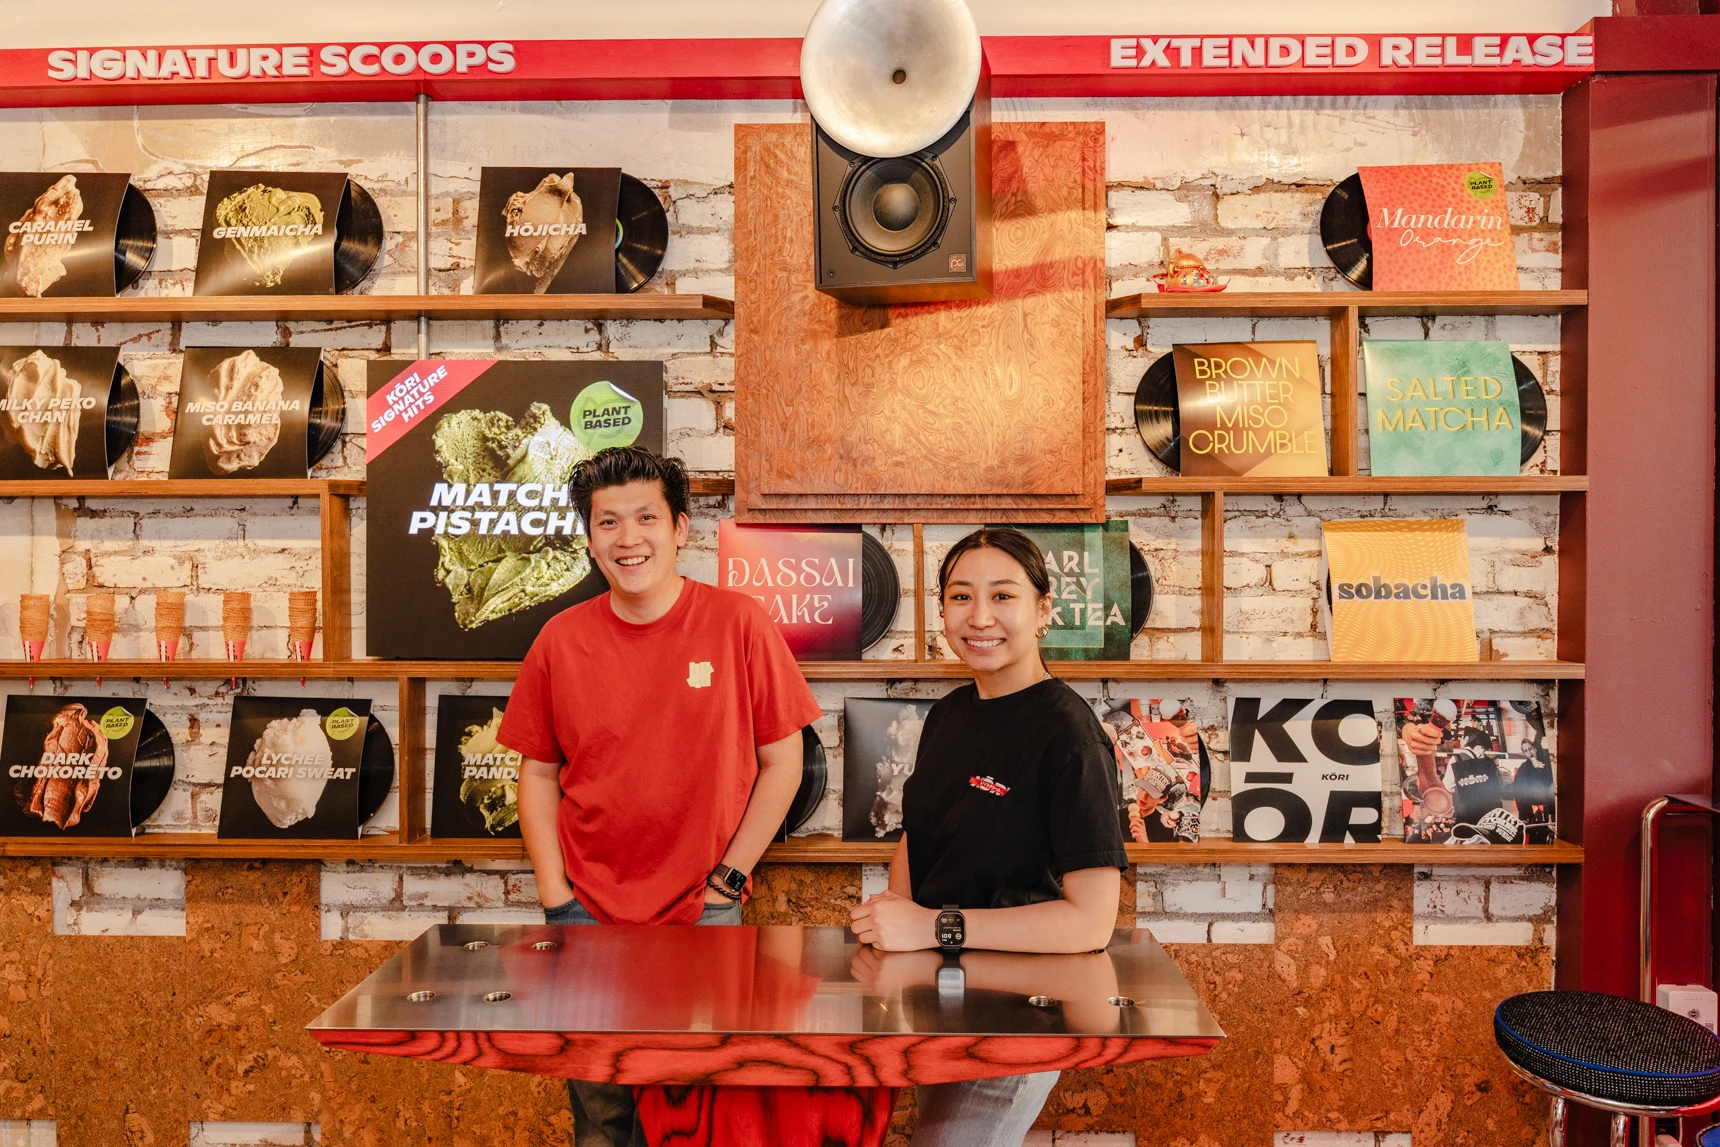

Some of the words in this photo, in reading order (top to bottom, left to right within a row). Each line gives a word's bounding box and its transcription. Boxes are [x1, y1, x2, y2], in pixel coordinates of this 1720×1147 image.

[47, 46, 313, 81] SIGNATURE
[320, 42, 516, 77] SCOOPS
[1110, 36, 1369, 68] EXTENDED
[1380, 35, 1594, 67] RELEASE
[9, 220, 94, 234] CARAMEL
[505, 222, 587, 237] HŌJICHA
[1377, 207, 1504, 230] Mandarin
[21, 232, 78, 246] PURIN
[213, 224, 323, 239] GENMAICHA
[1400, 229, 1504, 264] Orange
[1193, 356, 1300, 380] BROWN
[371, 365, 448, 433] SIGNATURE
[386, 372, 420, 405] KŌRI
[1205, 380, 1294, 404] BUTTER
[1386, 376, 1503, 401] SALTED
[48, 397, 96, 409] PEKO
[185, 401, 228, 413] MISO
[231, 400, 300, 412] BANANA
[401, 391, 434, 424] HITS
[582, 405, 631, 420] PLANT
[17, 411, 66, 423] CHAN
[201, 414, 280, 426] CARAMEL
[583, 416, 632, 430] BASED
[1215, 405, 1288, 428] MISO
[1378, 407, 1515, 432] MATCHA
[1188, 430, 1318, 455] CRUMBLE
[429, 482, 572, 507] MATCH
[408, 511, 584, 536] PISTACHI
[727, 557, 854, 587] DASSAI
[1045, 550, 1099, 574] ARL
[1048, 577, 1100, 600] REY
[1337, 576, 1467, 601] sobacha
[752, 594, 833, 625] AKE
[1069, 602, 1126, 626] TEA
[41, 752, 94, 765] DARK
[261, 753, 325, 765] LYCHEE
[891, 763, 915, 776] YU
[230, 766, 295, 779] POCARI
[296, 767, 356, 779] SWEAT
